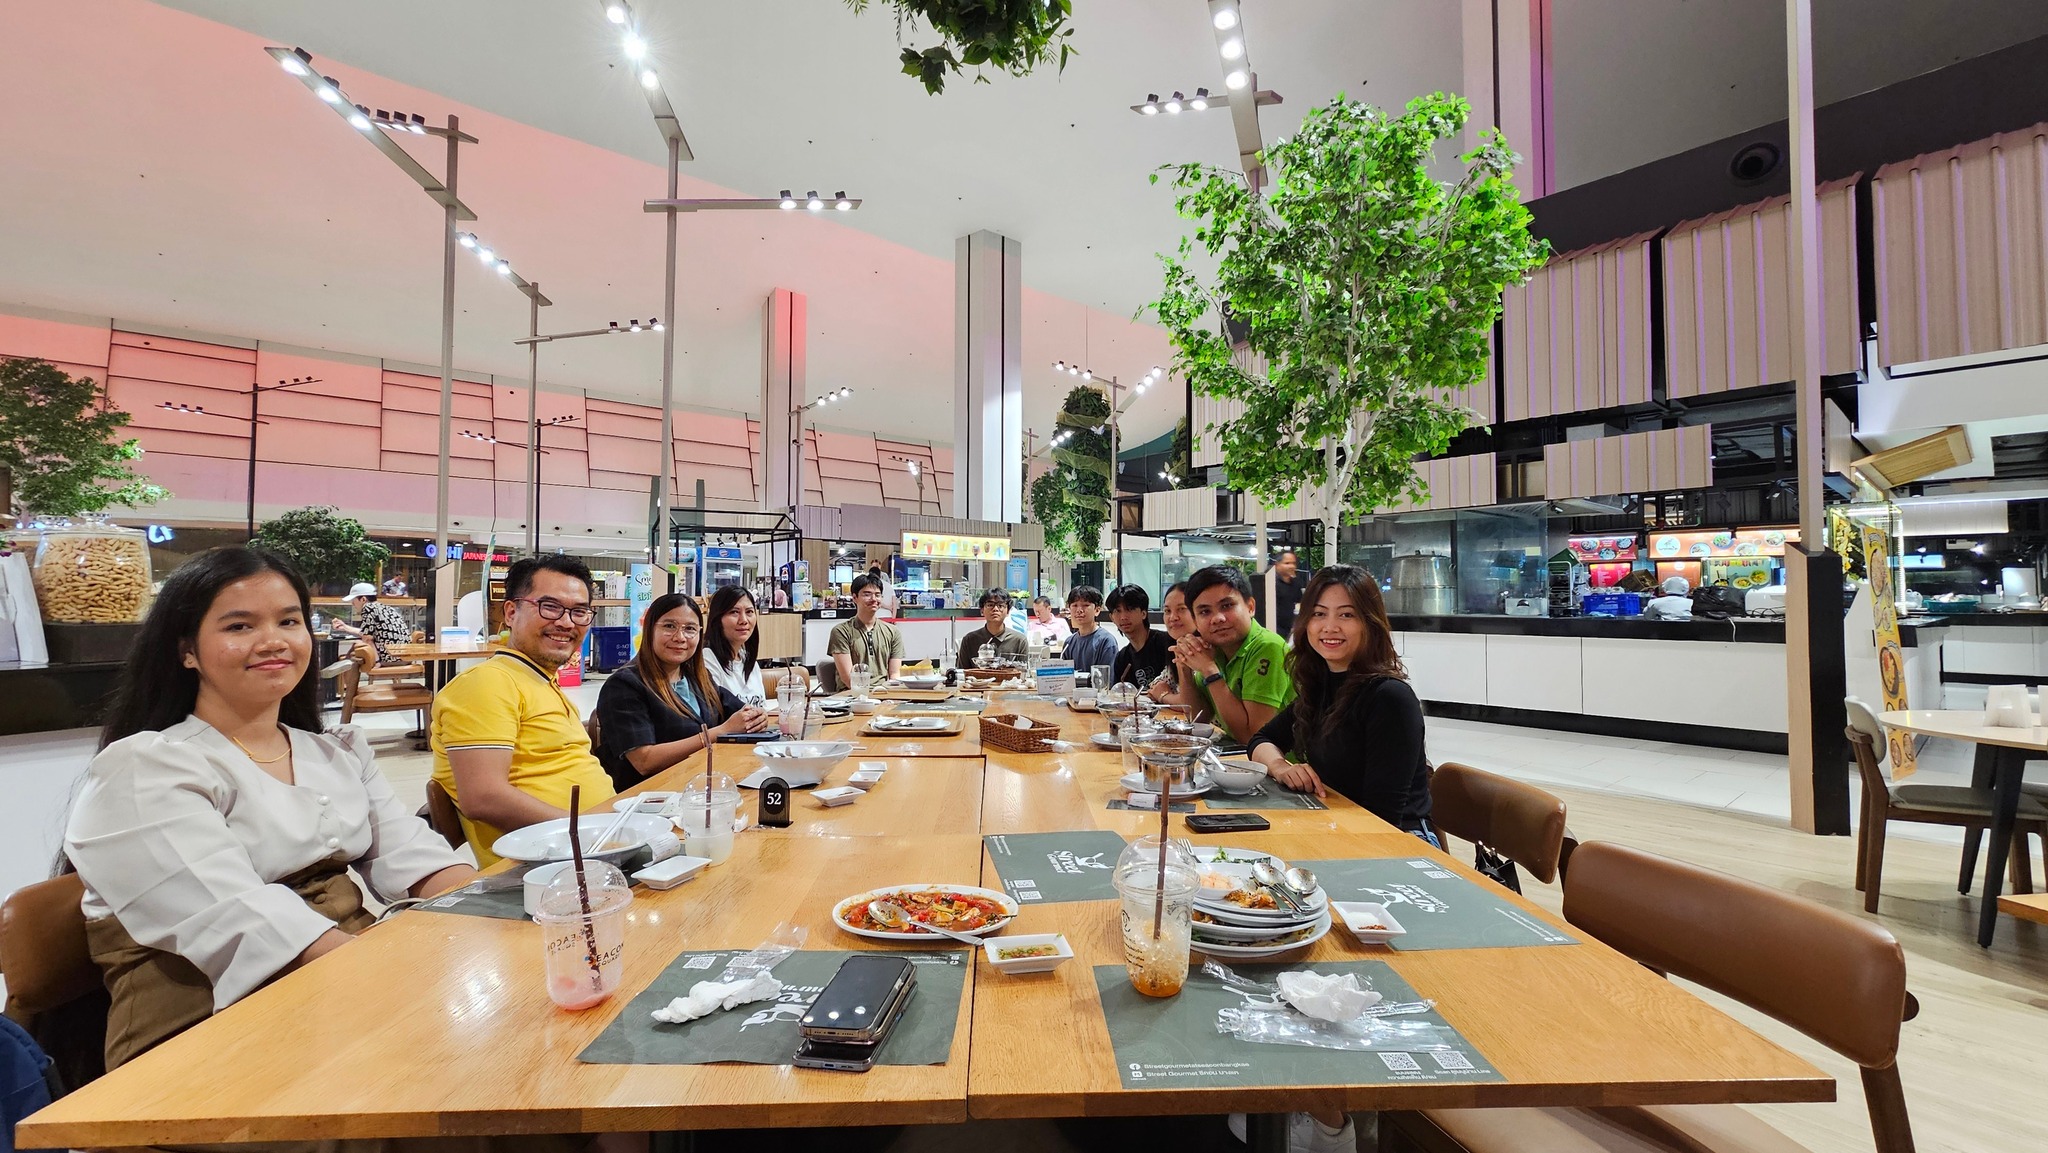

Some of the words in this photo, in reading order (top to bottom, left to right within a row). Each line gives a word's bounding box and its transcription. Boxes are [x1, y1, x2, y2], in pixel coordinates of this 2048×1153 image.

[425, 543, 462, 560] OHI
[1256, 658, 1271, 676] 3
[766, 792, 782, 805] 52
